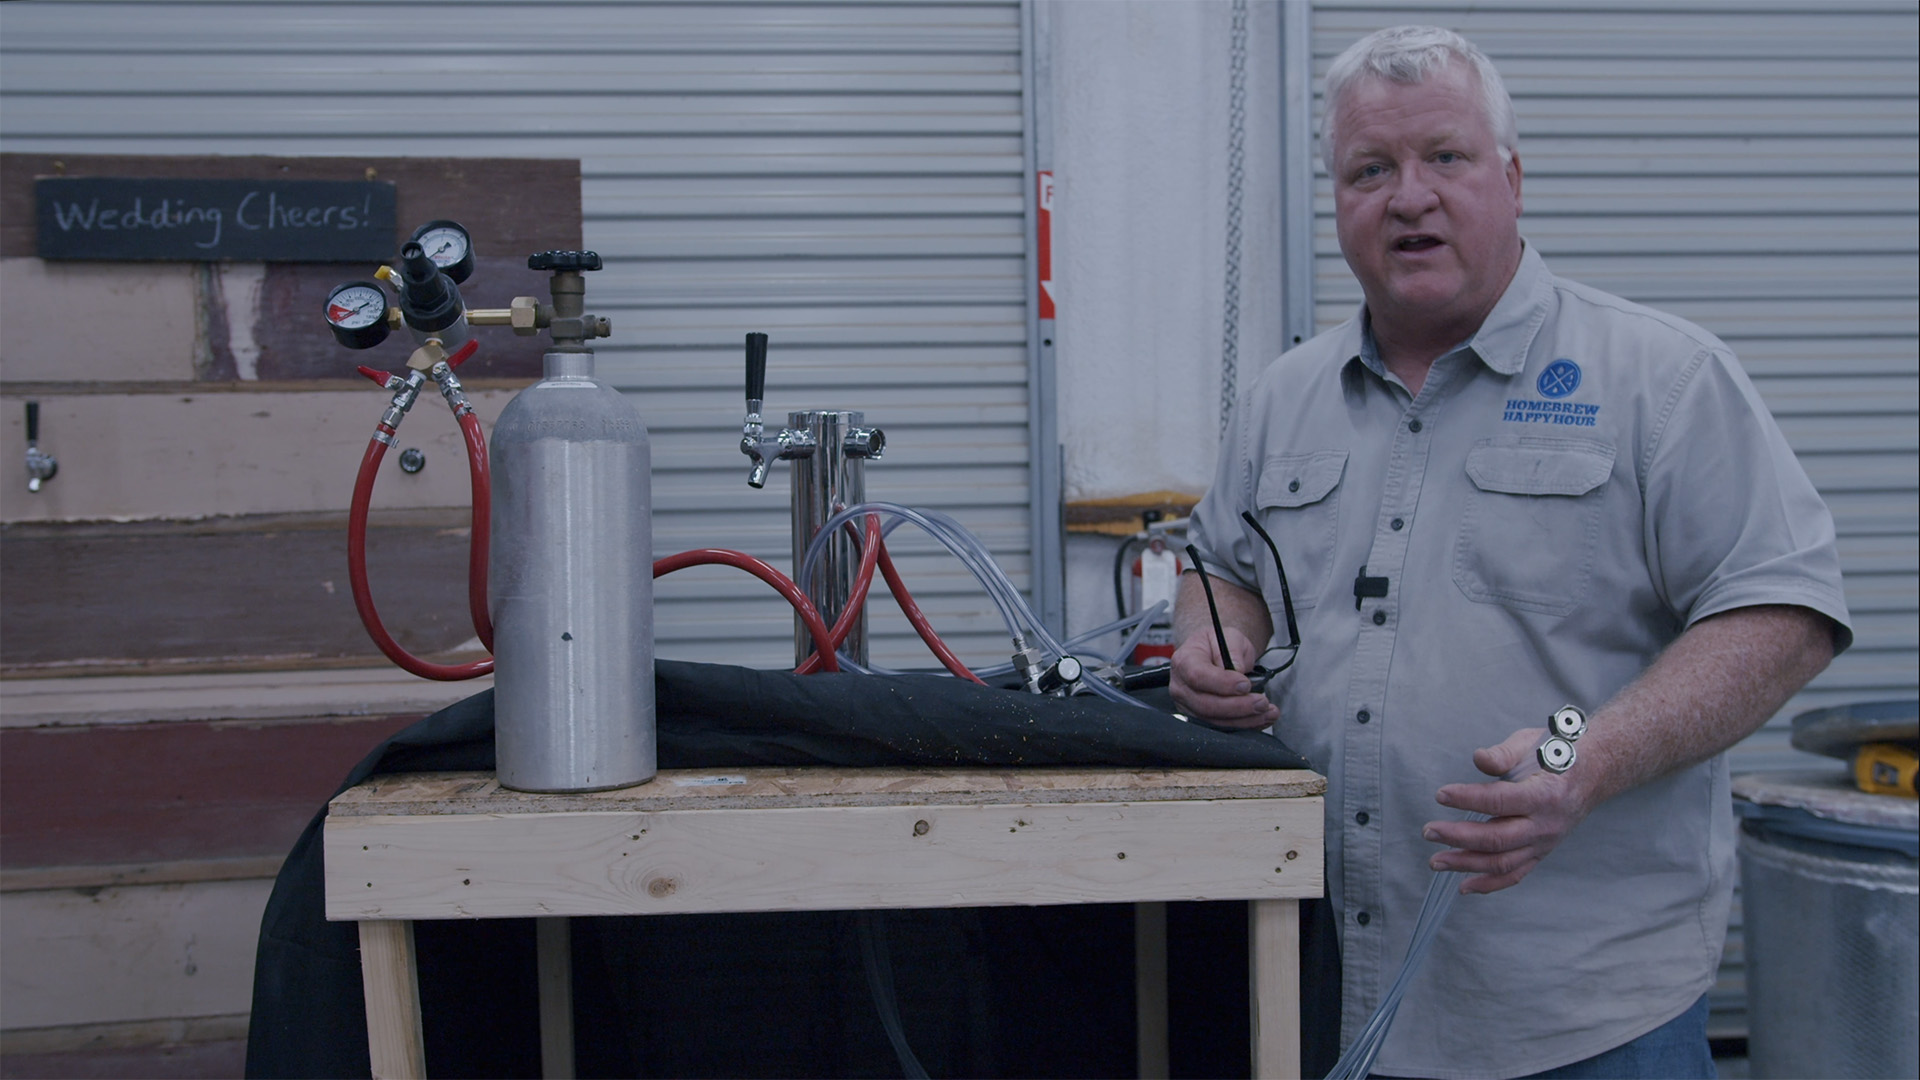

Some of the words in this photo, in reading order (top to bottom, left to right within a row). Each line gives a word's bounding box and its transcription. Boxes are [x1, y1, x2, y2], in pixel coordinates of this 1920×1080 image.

[53, 197, 222, 249] Wedding
[236, 191, 371, 230] Cheers!
[1505, 400, 1600, 415] HOMEBREW
[1503, 411, 1552, 423] HAPPY
[1553, 414, 1596, 426] HOUR
